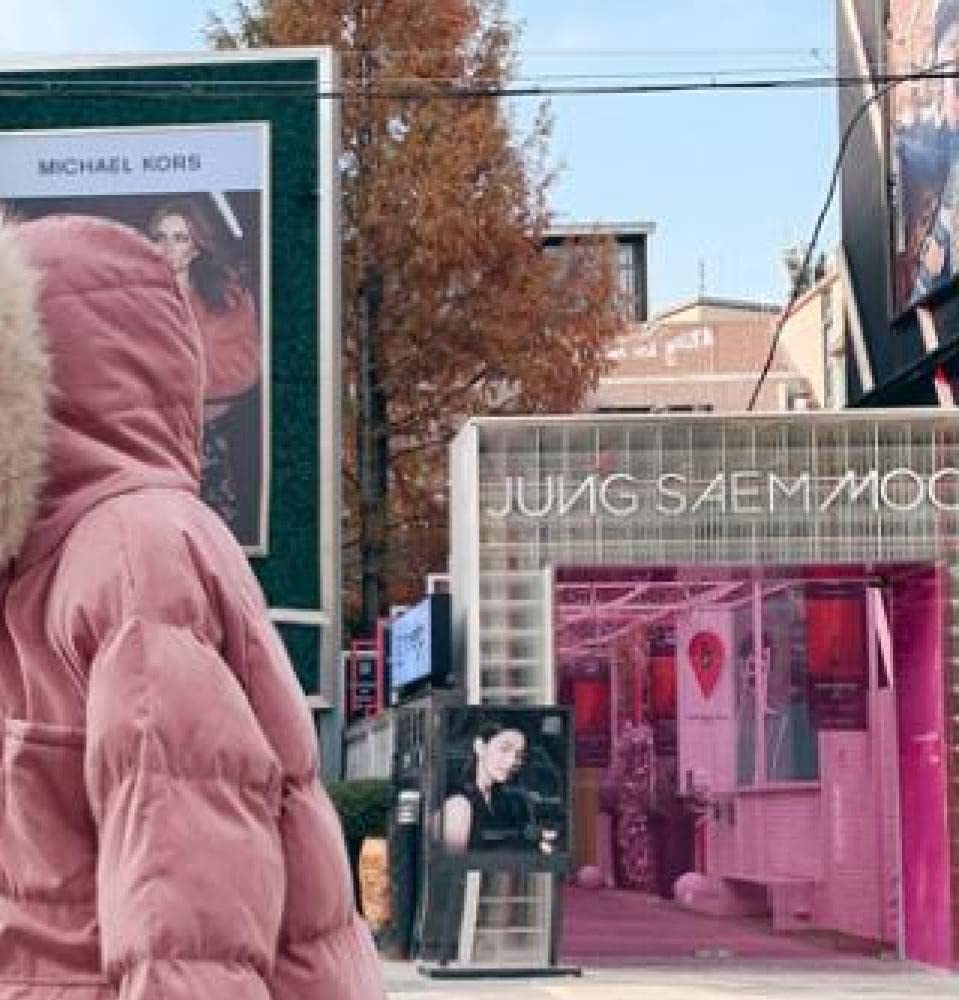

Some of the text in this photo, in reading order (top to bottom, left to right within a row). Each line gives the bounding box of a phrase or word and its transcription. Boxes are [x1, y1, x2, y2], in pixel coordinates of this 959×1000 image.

[38, 152, 201, 175] MICHAEL KORS
[656, 470, 811, 514] SAEM
